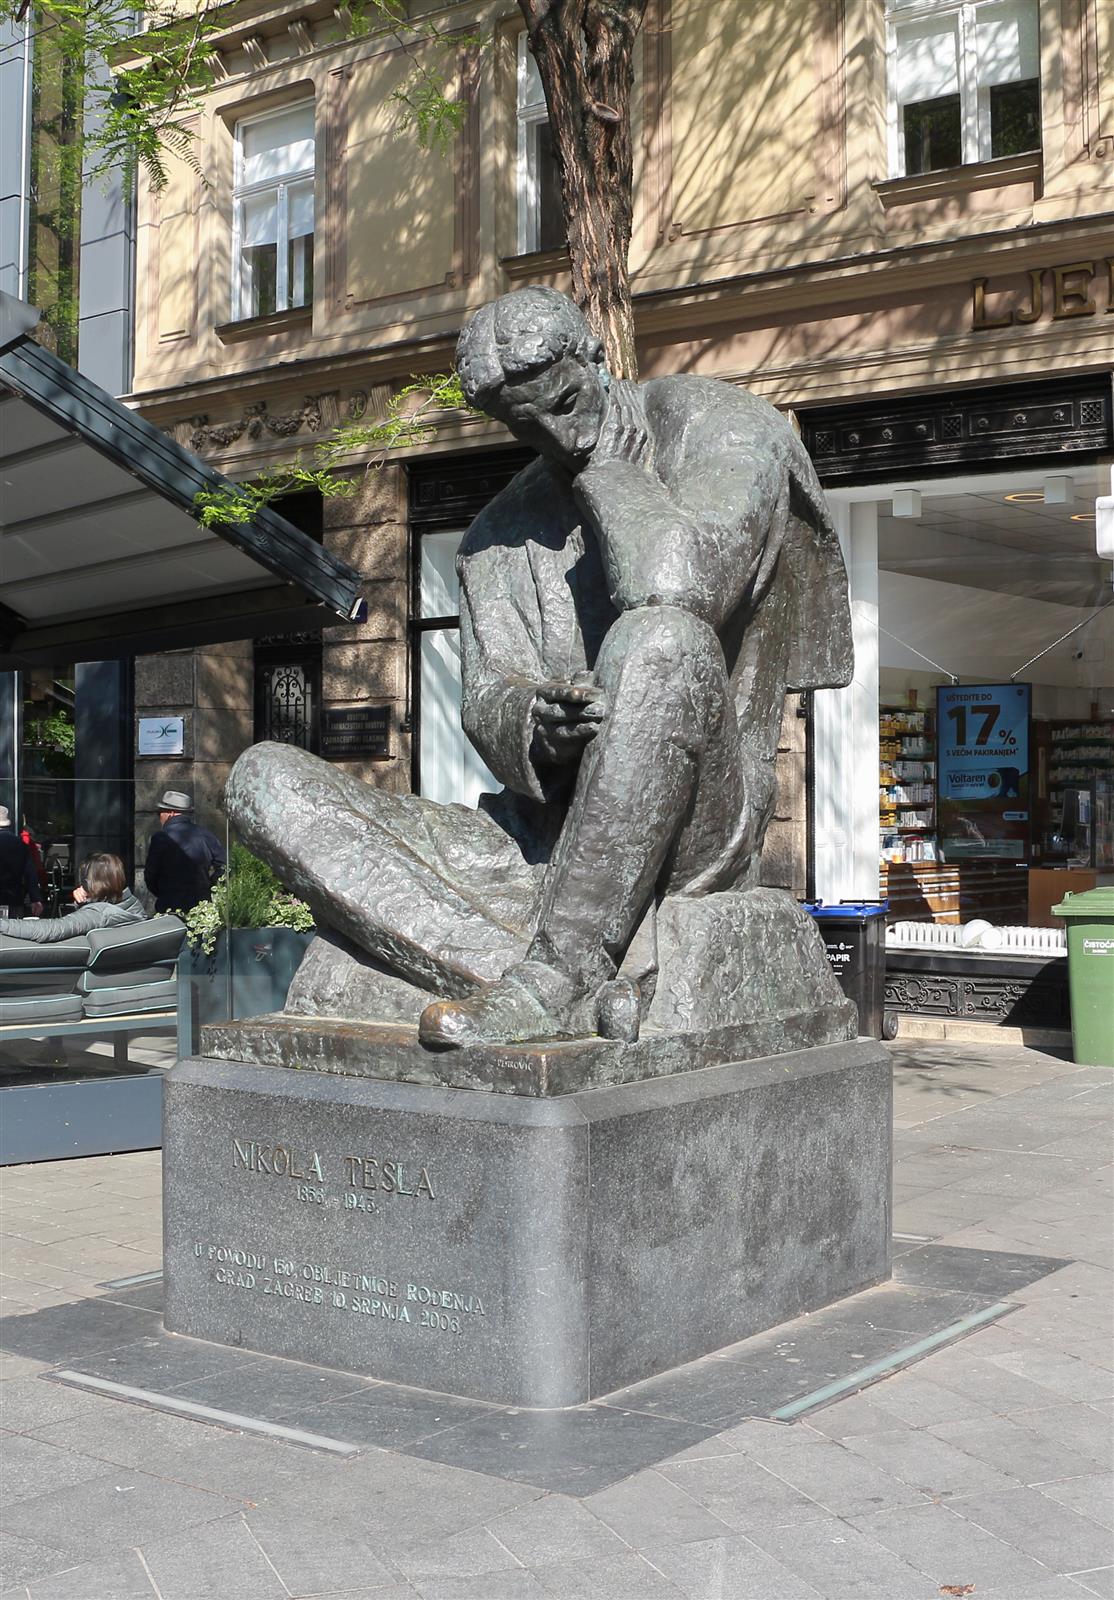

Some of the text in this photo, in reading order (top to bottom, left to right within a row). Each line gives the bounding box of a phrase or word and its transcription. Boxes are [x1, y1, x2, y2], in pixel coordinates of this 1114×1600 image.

[972, 256, 1114, 332] LJE
[948, 774, 986, 783] Voltaren
[233, 1139, 435, 1200] NIKOLA TESLA
[194, 1242, 203, 1258] U
[208, 1245, 266, 1271] POVODU
[303, 1263, 399, 1298] OBLJETNICE
[215, 1267, 256, 1290] GRAD
[263, 1277, 324, 1305] ZAGREB
[351, 1296, 411, 1324] SRPNJA
